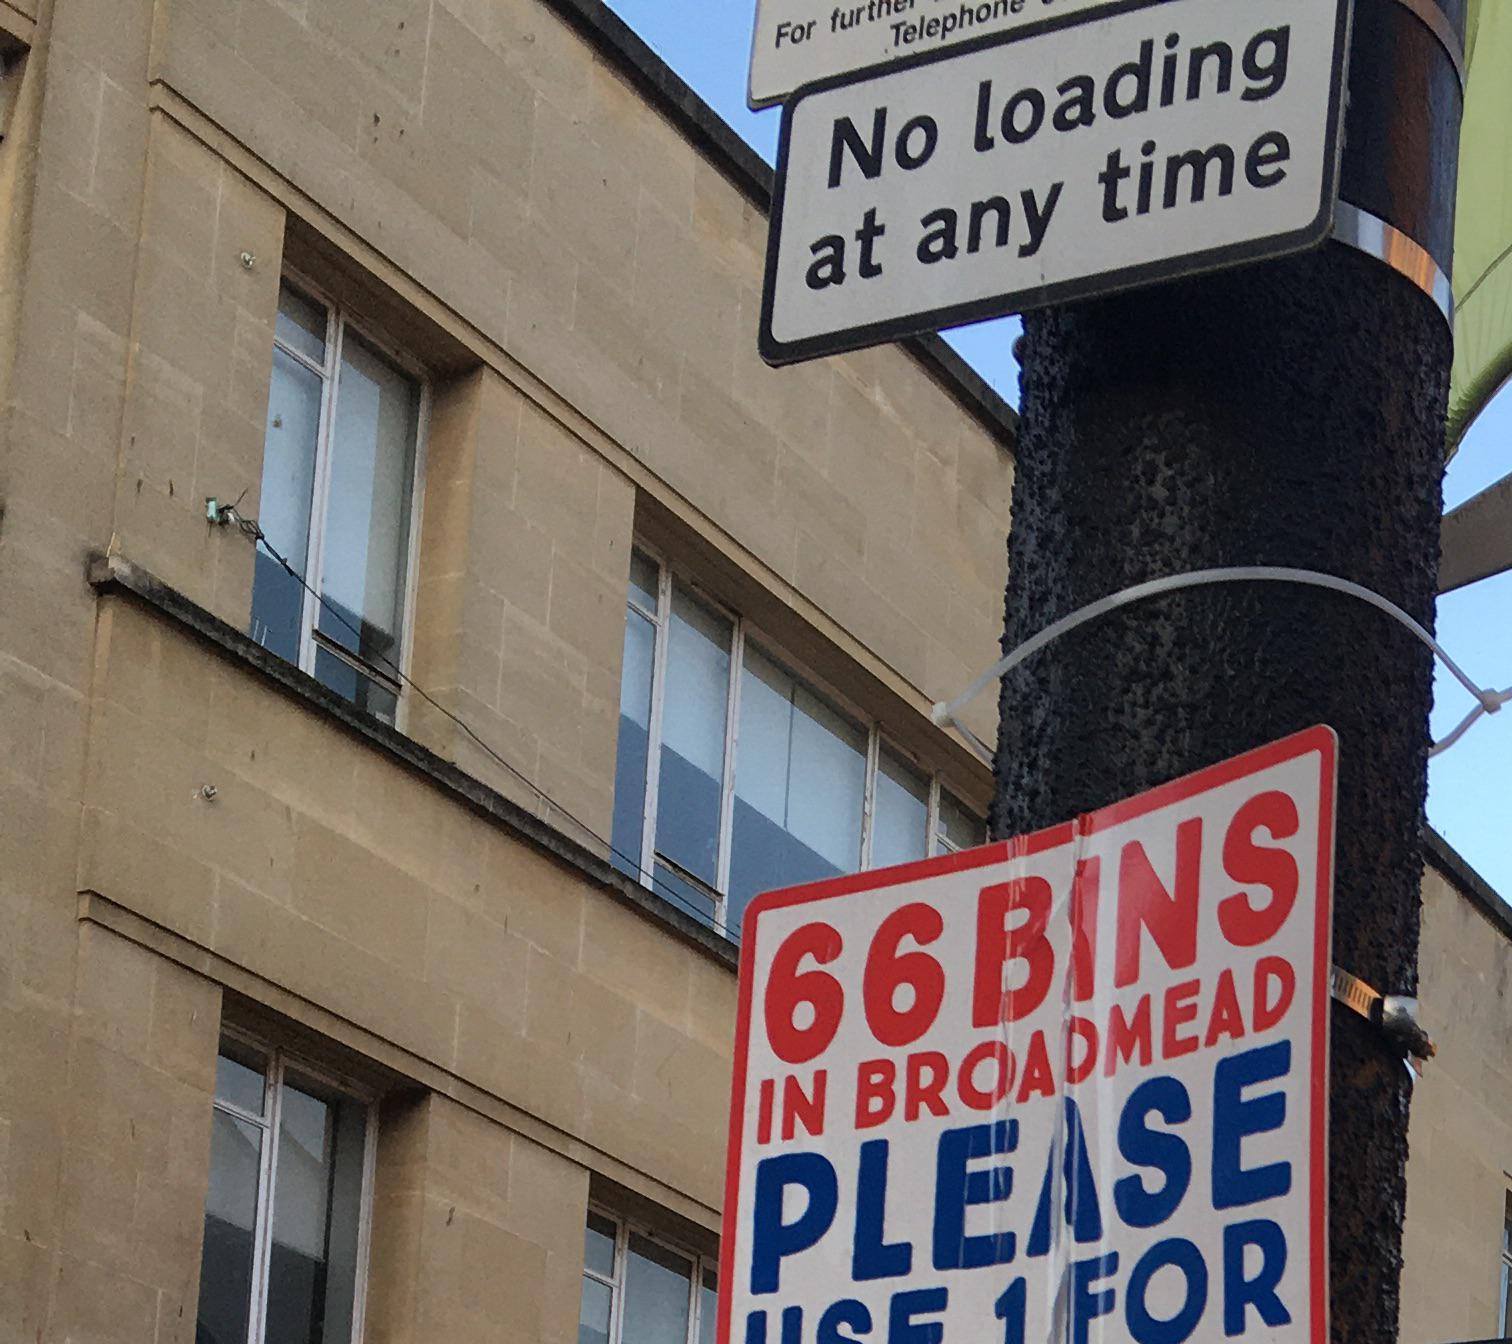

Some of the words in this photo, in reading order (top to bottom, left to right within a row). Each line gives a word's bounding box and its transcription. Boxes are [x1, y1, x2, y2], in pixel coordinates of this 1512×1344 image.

[775, 20, 817, 49] For
[828, 107, 939, 189] No
[974, 22, 1291, 153] loading
[890, 0, 1025, 48] Telephone
[804, 207, 885, 290] at
[916, 180, 1064, 258] any
[1098, 129, 1291, 223] time
[764, 902, 945, 1064] 66
[971, 789, 1300, 1029] BINS
[757, 1069, 828, 1145] IN
[854, 955, 1296, 1130] BROADMEAD
[749, 1039, 1293, 1296] PLEASE
